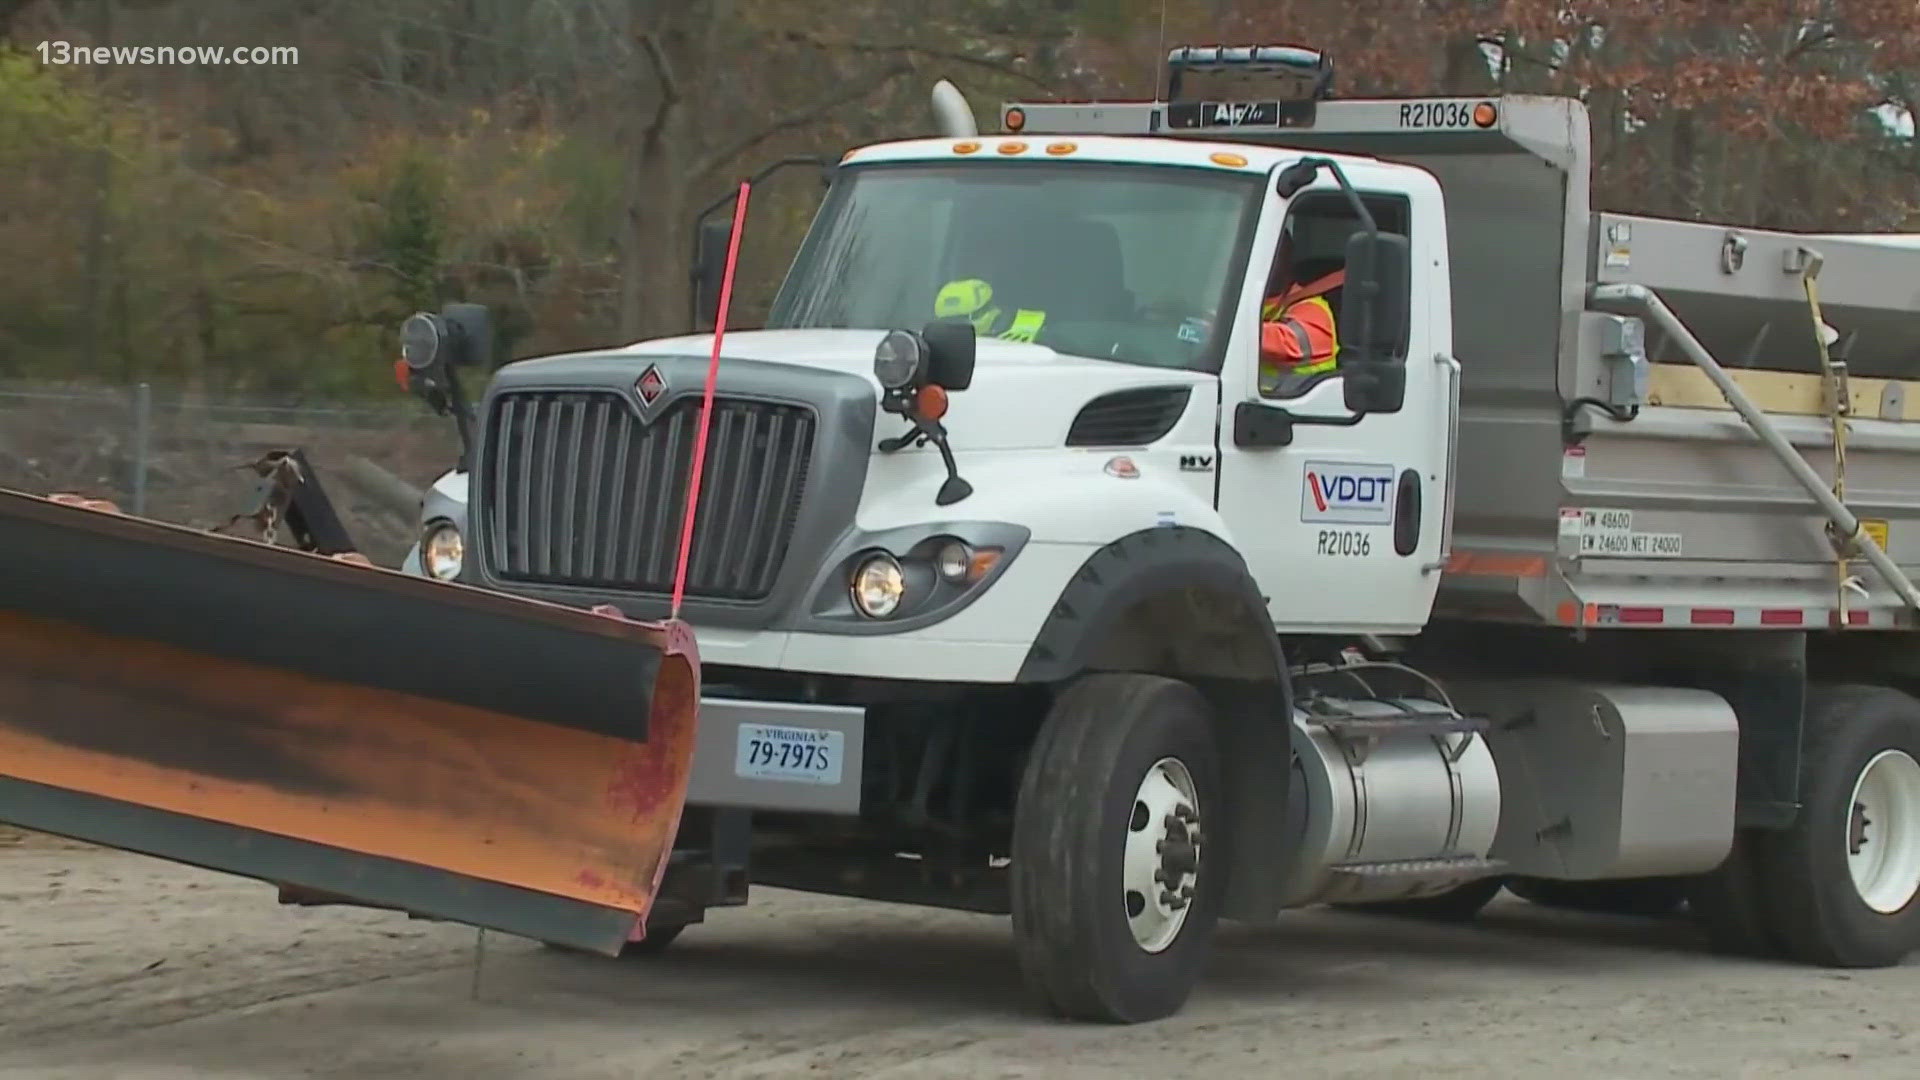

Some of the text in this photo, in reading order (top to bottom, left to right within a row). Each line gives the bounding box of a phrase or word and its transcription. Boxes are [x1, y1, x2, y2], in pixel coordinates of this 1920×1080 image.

[1400, 103, 1470, 128] R21036
[1321, 475, 1392, 503] VDOT
[1583, 511, 1596, 527] GW
[1317, 530, 1371, 557] R21036
[1581, 534, 1681, 553] EW 24600 NET 24000
[765, 728, 817, 743] VIRGINIA
